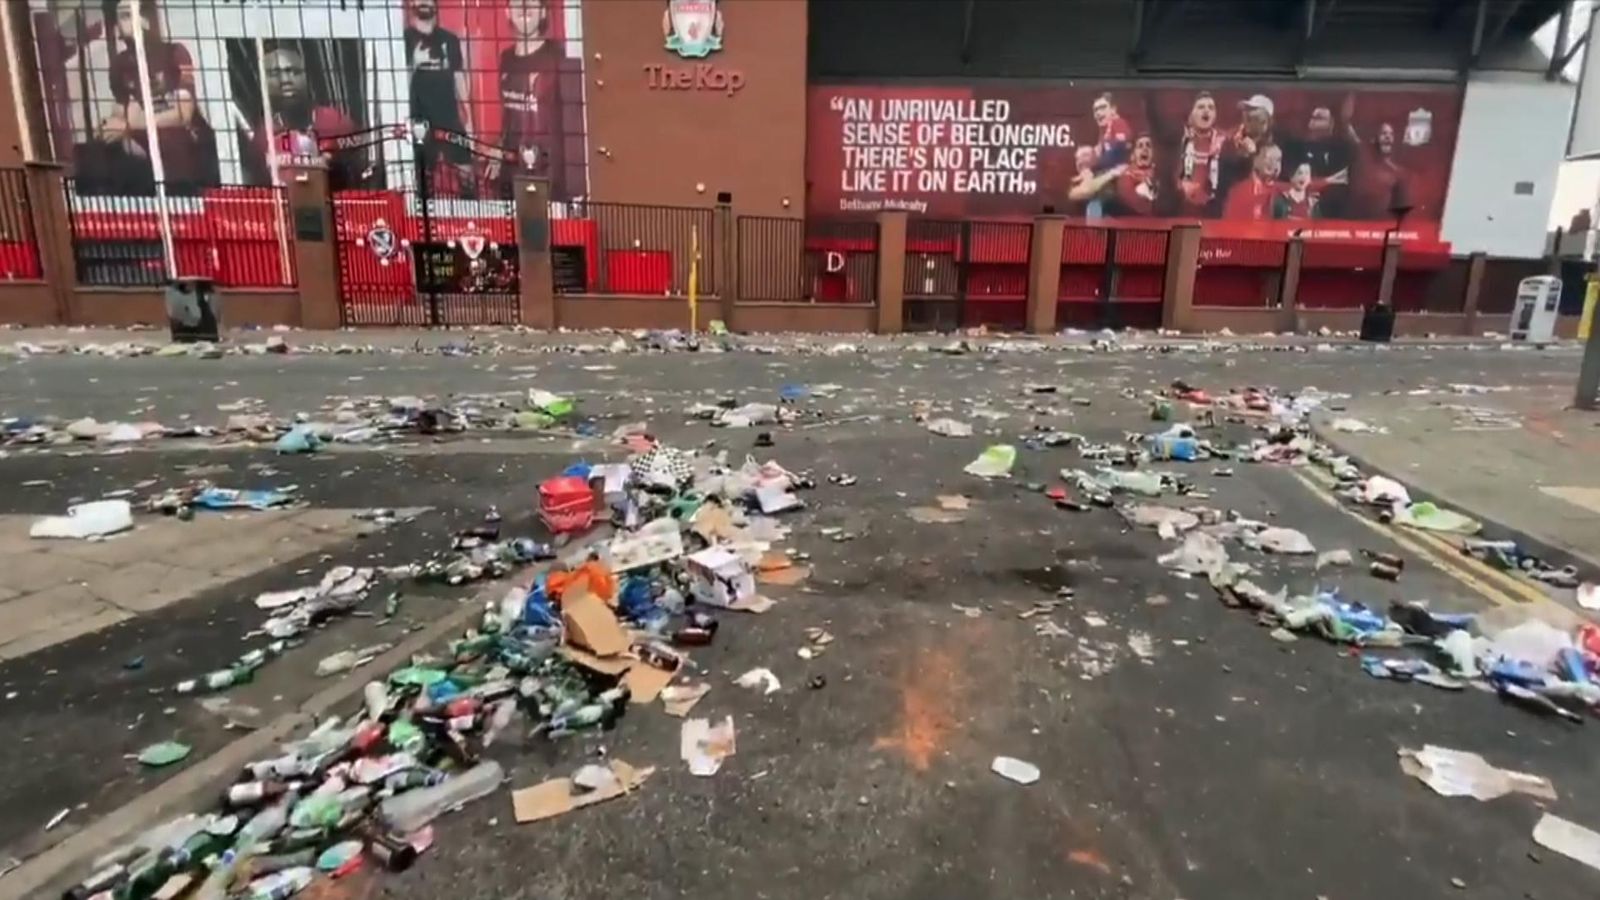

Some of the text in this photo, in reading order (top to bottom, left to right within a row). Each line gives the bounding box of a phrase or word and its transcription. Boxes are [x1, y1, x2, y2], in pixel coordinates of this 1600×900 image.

[643, 63, 745, 98] The Kop
[880, 99, 1010, 121] UNRIVALLED
[843, 123, 1075, 147] SENSE OF BELONGING.
[842, 146, 1037, 169] THERE'S NO PLACE
[841, 170, 887, 192] LIKE
[892, 170, 912, 192] IT
[917, 170, 948, 192] ON
[826, 251, 844, 272] D
